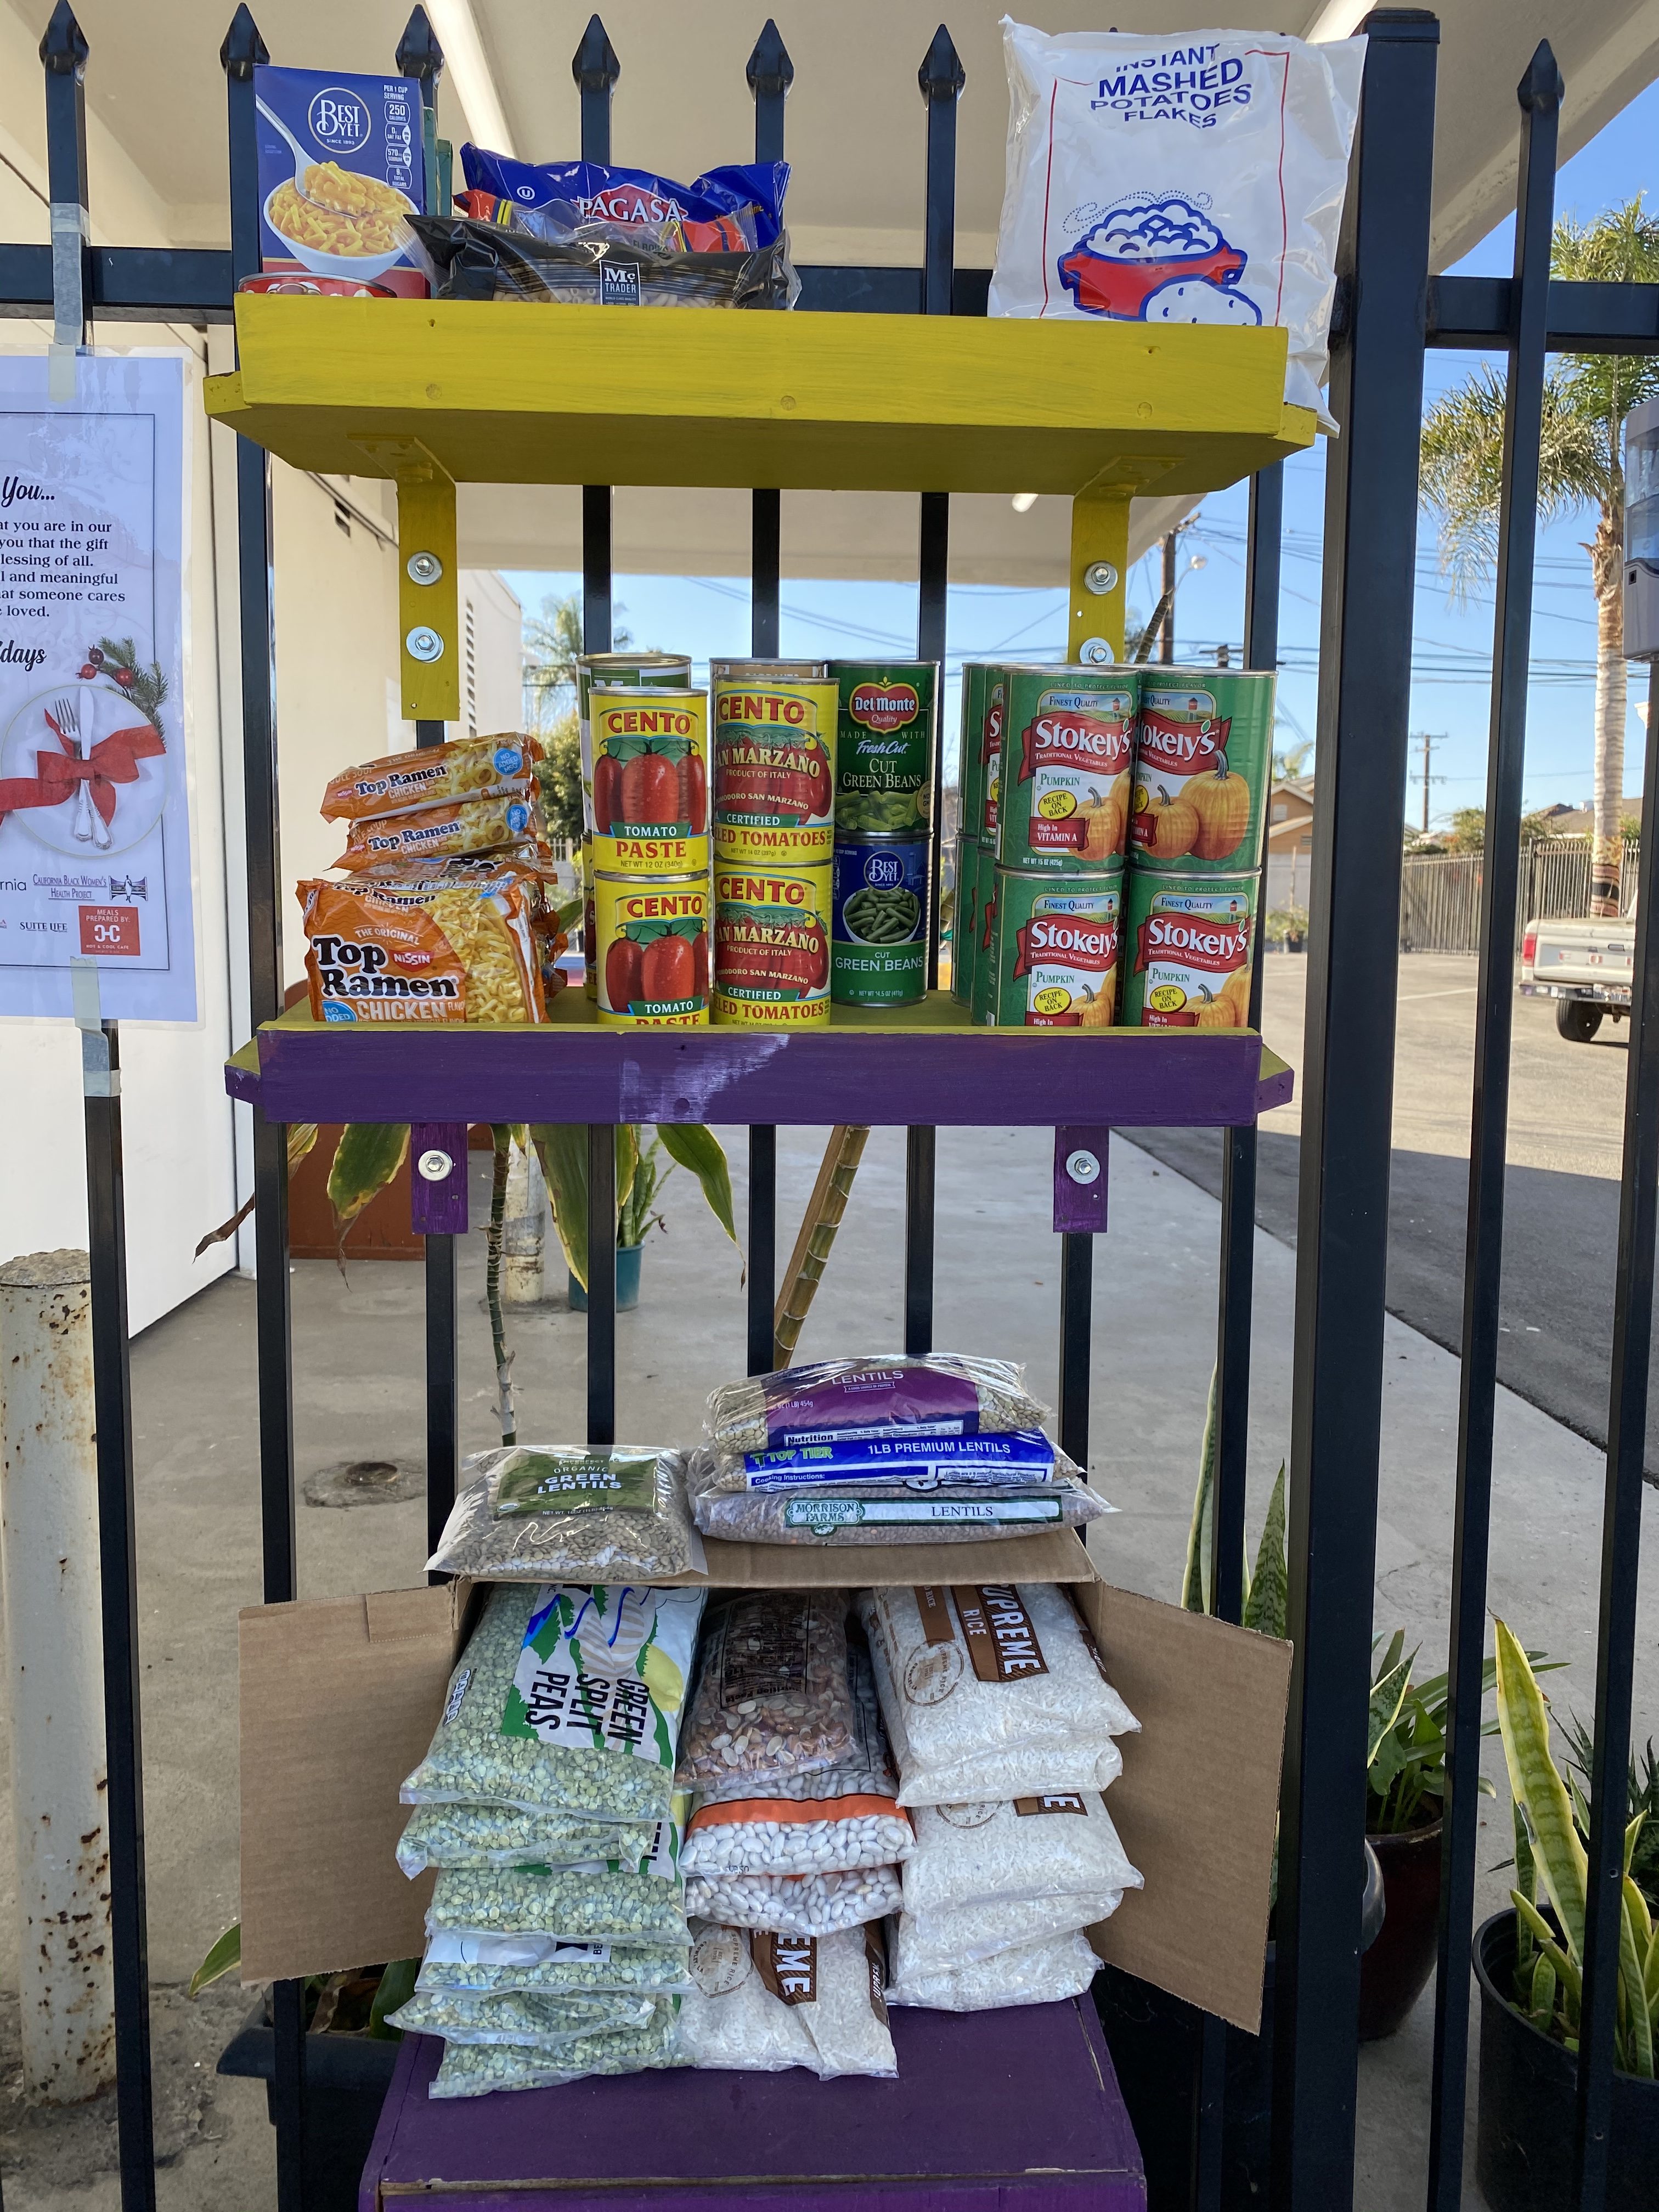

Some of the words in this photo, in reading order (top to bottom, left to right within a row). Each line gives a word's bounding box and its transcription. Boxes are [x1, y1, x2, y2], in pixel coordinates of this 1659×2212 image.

[1099, 58, 1243, 98] MASHED
[384, 92, 404, 100] SERVING
[1091, 83, 1251, 111] POTATOES
[317, 99, 360, 136] BEST
[389, 104, 405, 116] 250
[1124, 109, 1217, 129] FLAKES
[340, 122, 360, 137] YET
[579, 198, 684, 223] PAGASA
[605, 283, 636, 294] TRADER
[1, 476, 55, 507] You...
[13, 522, 39, 533] you
[44, 523, 66, 531] are
[71, 521, 83, 532] in
[88, 523, 112, 532] our
[0, 539, 23, 550] you
[29, 538, 55, 548] that
[60, 538, 81, 549] the
[86, 539, 108, 551] gift
[55, 554, 67, 566] of
[73, 555, 93, 566] all.
[9, 572, 35, 582] and
[41, 573, 118, 586] meaningful
[19, 592, 83, 601] someone
[88, 592, 125, 601] cares
[7, 606, 49, 617] loved.
[855, 697, 874, 711] Del
[877, 697, 915, 712] Monte
[1049, 696, 1072, 706] FINEST
[1074, 697, 1099, 708] QUALITY
[1151, 695, 1171, 706] QUALITY
[719, 696, 804, 724] CENTO
[607, 712, 691, 734] CENTO
[871, 714, 898, 724] Quality
[840, 731, 867, 739] MADE
[901, 731, 925, 739] WITH
[1035, 719, 1131, 760] Stokely's
[856, 740, 885, 755] Fresh
[885, 741, 911, 754] Cut
[498, 755, 518, 768] ADDED
[732, 747, 820, 778] MARZANO
[869, 759, 897, 774] CUT
[1035, 752, 1073, 760] TRADITIONAL
[1074, 754, 1108, 767] VEGETABLES
[504, 763, 518, 772] MSG
[726, 769, 755, 778] PRODUCT
[770, 771, 791, 780] ITALY
[356, 780, 386, 794] Top
[387, 765, 447, 787] Ramen
[843, 772, 882, 788] GREEN
[885, 773, 921, 788] BEANS
[1040, 774, 1080, 786] PUMPKIN
[388, 782, 427, 799] CHICKEN
[767, 794, 809, 810] MARZANO
[1043, 793, 1067, 805] RECIPE
[727, 813, 780, 826] CERTIFIED
[1048, 807, 1068, 817] BACK
[367, 820, 387, 833] SOUP
[624, 825, 677, 837] TOMATO
[369, 837, 400, 849] Top
[402, 822, 460, 842] Ramen
[740, 831, 826, 847] TOMATOES
[1037, 832, 1071, 842] VITAMIN
[401, 838, 439, 855] CHICKEN
[616, 841, 686, 858] PASTE
[868, 859, 898, 882] BEST
[883, 873, 898, 882] YET
[64, 876, 79, 885] BLACK
[51, 888, 70, 898] HEALTH
[72, 888, 92, 899] PROJECT
[719, 878, 805, 905] CENTO
[627, 896, 702, 918] CENTO
[1161, 898, 1183, 907] FINEST
[1185, 900, 1212, 910] QUALITY
[20, 922, 47, 930] SUITE
[355, 929, 374, 938] THE
[375, 928, 420, 945] ORIGINAL
[733, 926, 819, 953] MARZANO
[1030, 917, 1119, 957] Stokely's
[1149, 918, 1247, 959] Stokely's
[313, 936, 385, 974] Top
[393, 953, 431, 964] NISSIN
[1148, 949, 1183, 957] TRADITIONAL
[1184, 952, 1220, 966] VEGETABLES
[835, 956, 880, 972] GREEN
[885, 956, 923, 970] BEANS
[1153, 968, 1190, 982] PUMPKIN
[321, 969, 457, 997] Ramen
[1155, 989, 1177, 997] RECIPE
[357, 1001, 448, 1020] CHICKEN
[645, 1000, 693, 1014] TOMATO
[742, 1002, 823, 1020] TOMATOES
[1159, 1001, 1177, 1009] BACK
[832, 1370, 904, 1385] LENTILS
[788, 1434, 833, 1443] Nutrition
[771, 1449, 796, 1462] TOP
[803, 1447, 833, 1459] TIER
[867, 1444, 891, 1454] 1LB
[895, 1442, 955, 1453] PREMIUM
[958, 1442, 1011, 1454] LENTILS
[545, 1474, 616, 1484] GREEN
[538, 1481, 622, 1494] LENTILS
[795, 1503, 855, 1513] MORRISON
[932, 1506, 993, 1517] LENTILS
[805, 1513, 844, 1522] FARMS
[963, 1609, 987, 1635] RICE
[982, 1584, 1042, 1675] UPREME
[525, 1670, 571, 1730] PEAS
[566, 1673, 610, 1736] SPLIT
[607, 1678, 650, 1745] GREEN
[975, 1804, 985, 1819] RICE
[724, 1968, 735, 1985] RICE
